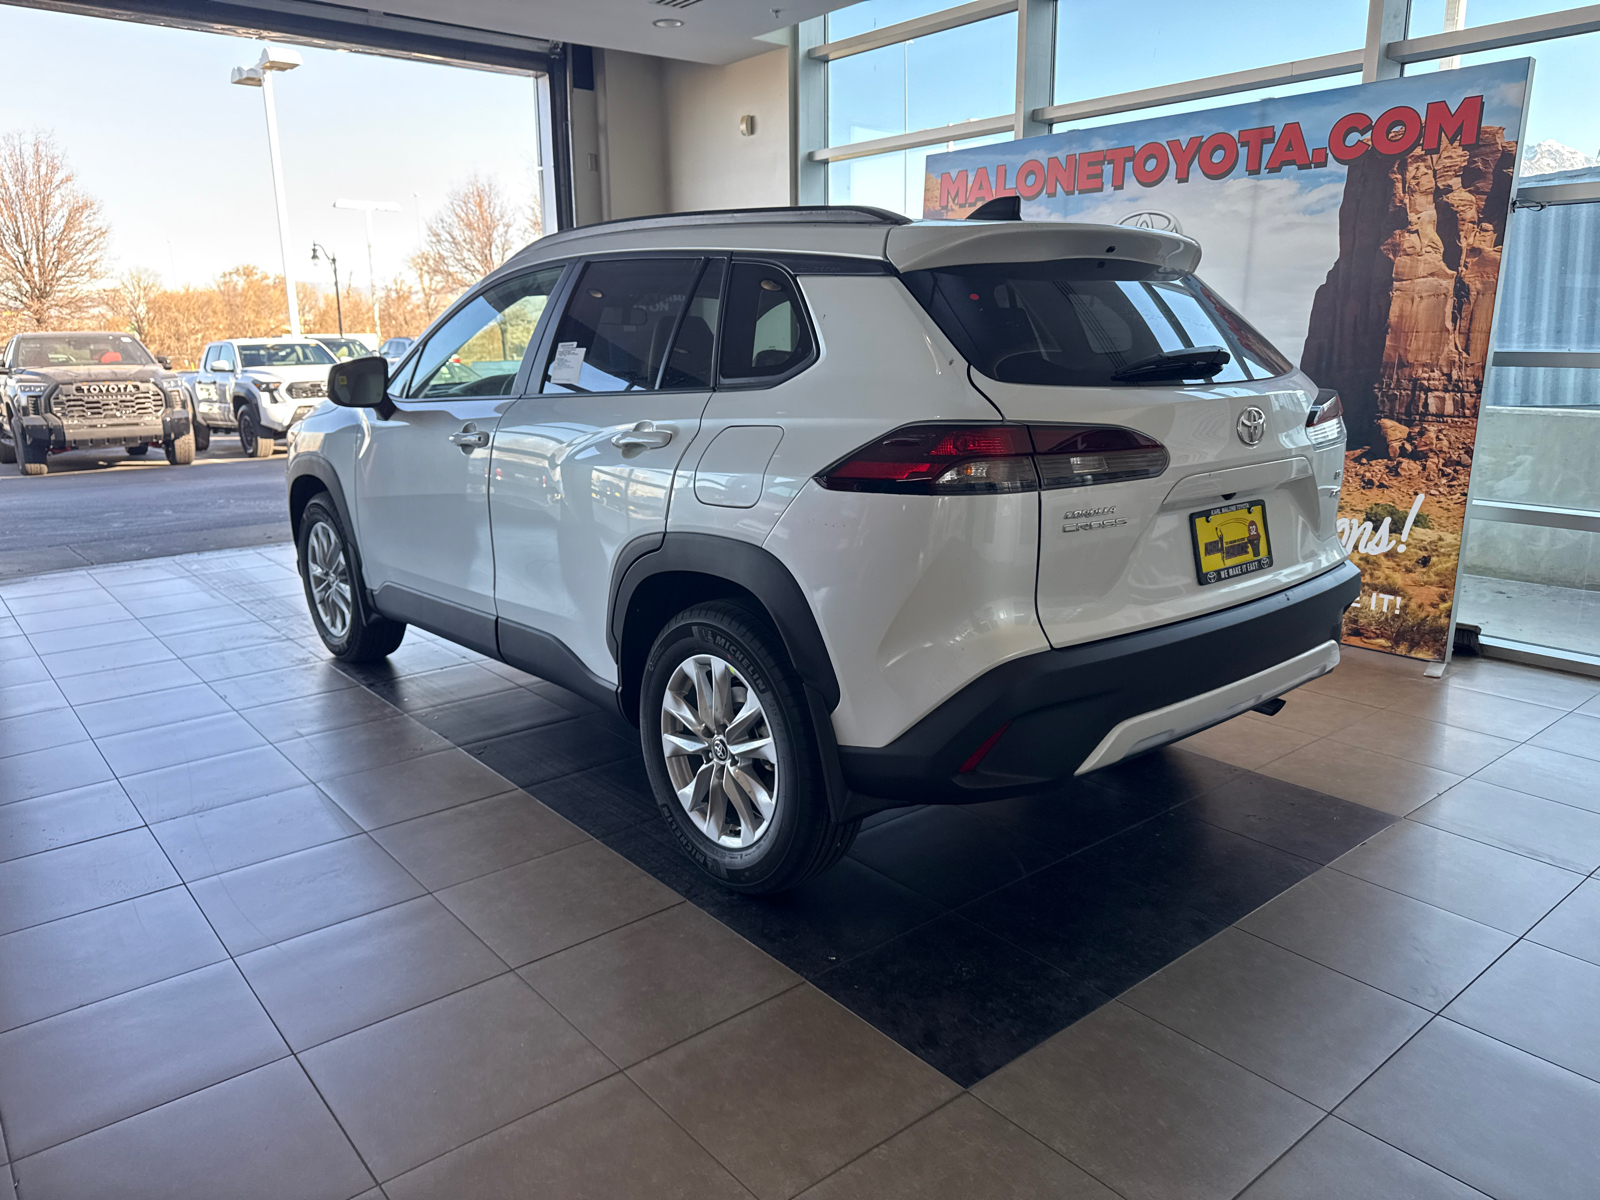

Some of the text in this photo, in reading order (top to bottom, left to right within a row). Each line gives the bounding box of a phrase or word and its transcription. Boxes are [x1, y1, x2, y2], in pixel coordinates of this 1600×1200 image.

[940, 96, 1485, 207] MALONETOYOTA.COM
[81, 384, 135, 394] TOYOTA
[1063, 505, 1116, 519] COROLLA
[1062, 517, 1127, 533] CROSS
[1249, 525, 1257, 535] 32
[1220, 570, 1228, 578] WE
[1228, 566, 1241, 577] MAKE
[1247, 561, 1259, 571] EASY
[1370, 592, 1401, 615] IT!
[715, 636, 767, 691] MICHELIN
[661, 805, 706, 863] MICHELIN
